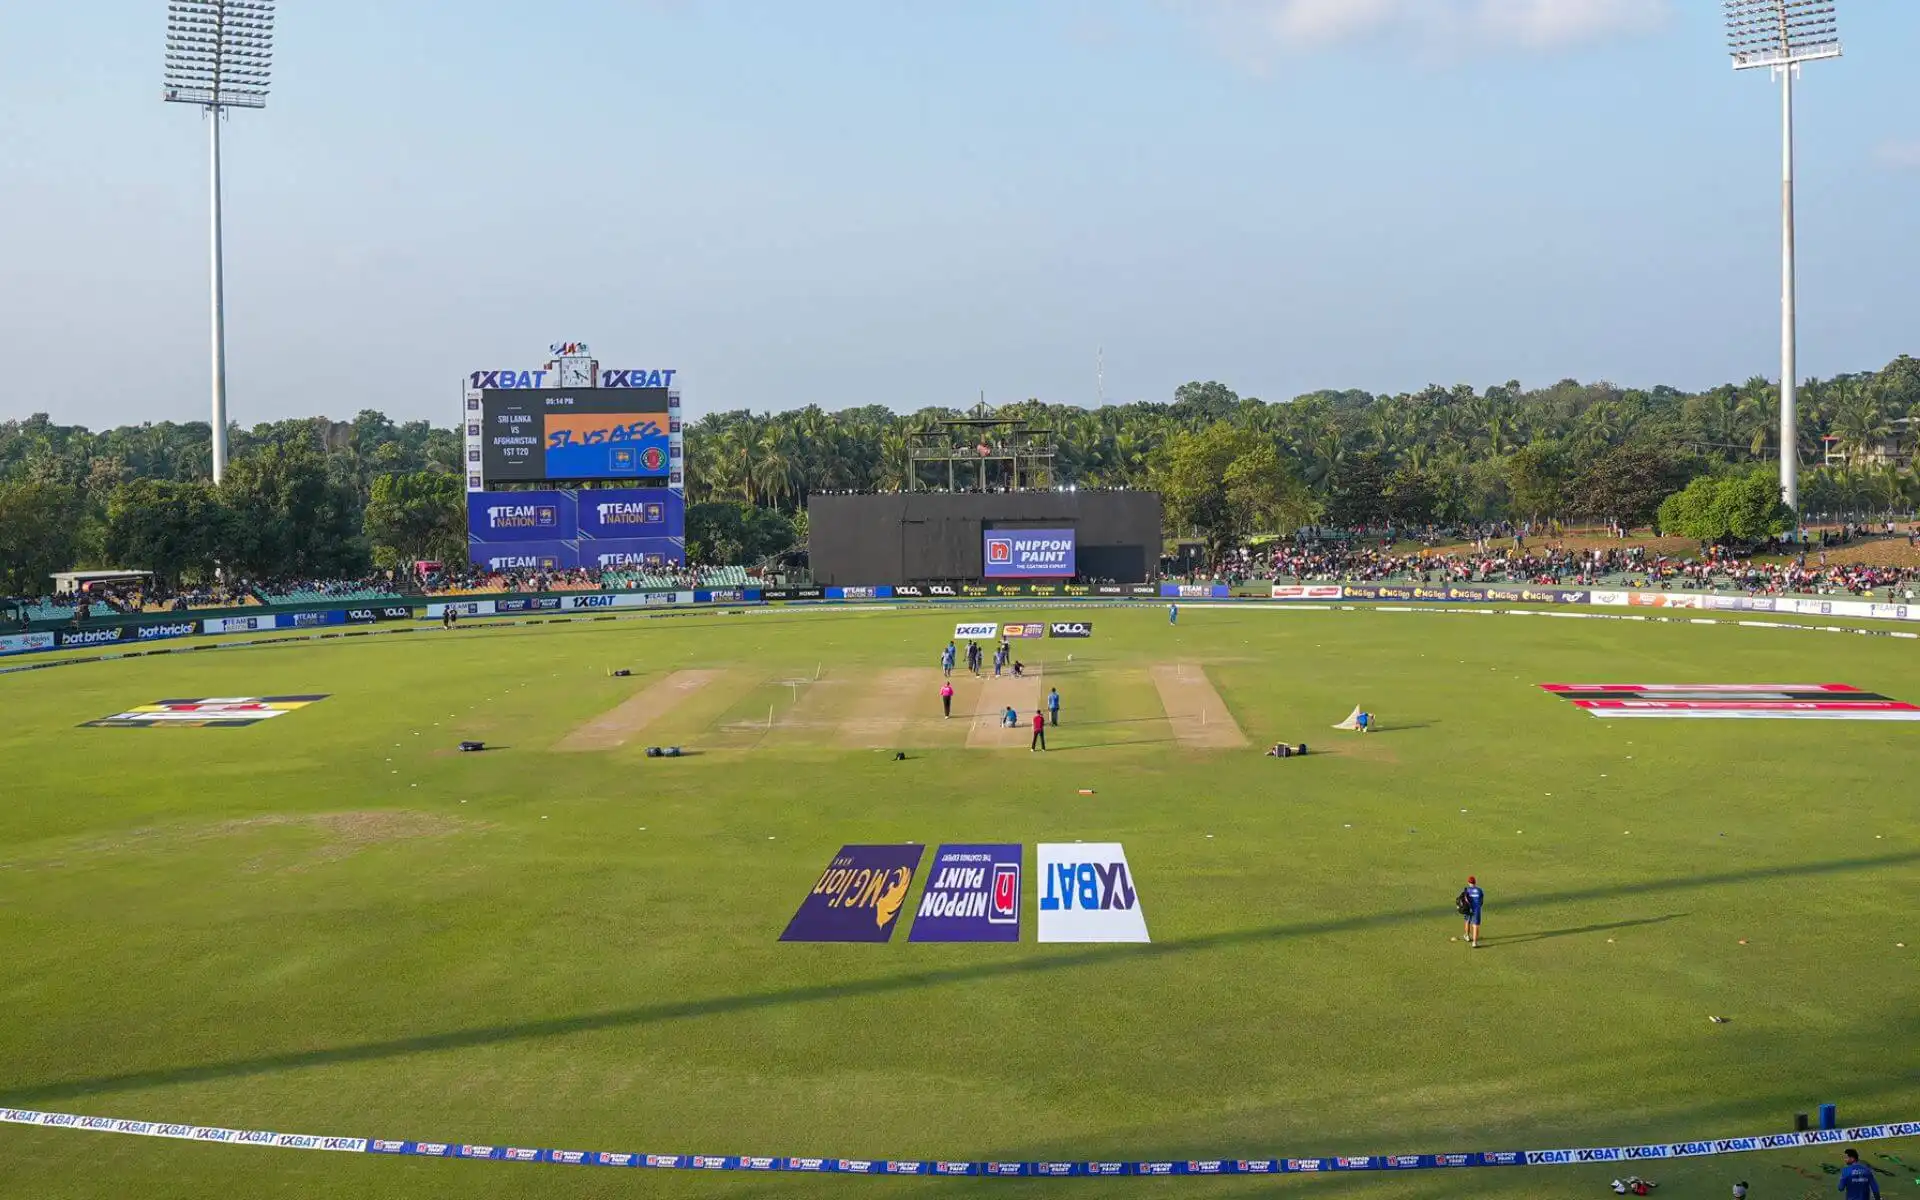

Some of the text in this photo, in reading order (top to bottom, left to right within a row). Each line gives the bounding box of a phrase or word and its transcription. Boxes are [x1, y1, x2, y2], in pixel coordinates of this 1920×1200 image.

[470, 370, 547, 389] 1XBAT
[601, 369, 677, 387] 1XBAT
[497, 415, 532, 423] SRI LANKA
[511, 426, 520, 434] VS
[493, 437, 537, 445] AFGHANISTAN
[503, 447, 529, 456] 1ST T20
[498, 505, 535, 517] TEAM
[607, 503, 643, 514] TEAM
[497, 517, 535, 527] NATION
[606, 513, 643, 524] NATION
[1015, 540, 1072, 551] NIPPON
[499, 556, 536, 568] TEAM
[608, 553, 644, 564] TEAM
[1021, 551, 1066, 562] PAINT
[895, 586, 917, 595] YOLO
[929, 586, 951, 595] YOLO
[572, 595, 617, 607] 1XBAT
[349, 609, 371, 618] YOLO
[384, 607, 406, 616] YOLO
[956, 626, 998, 635] 1XBAT
[1051, 623, 1083, 633] YOLO
[934, 867, 985, 889] PAINT
[1040, 862, 1135, 911] 1XBAT
[918, 891, 988, 917] NIPPON
[4, 1109, 40, 1122] 1XBAT
[43, 1113, 78, 1126] 1XBAT
[81, 1117, 116, 1129] 1XBAT
[117, 1120, 154, 1133] 1XBAT
[1889, 1122, 1920, 1136] 1XBA
[157, 1124, 194, 1137] 1XBAT
[196, 1128, 234, 1140] 1XBAT
[238, 1130, 277, 1143] 1XBAT
[1804, 1130, 1843, 1143] 1XBAT
[1847, 1126, 1886, 1139] 1XBAT
[280, 1134, 320, 1147] 1XBAT
[323, 1138, 365, 1150] 1XBAT
[1717, 1138, 1757, 1151] 1XBAT
[1761, 1134, 1801, 1146] 1XBAT
[1577, 1148, 1621, 1161] 1XBAT
[1625, 1145, 1668, 1158] 1XBAT
[1671, 1142, 1713, 1155] 1XBAT
[1527, 1149, 1572, 1163] 1XBAT
